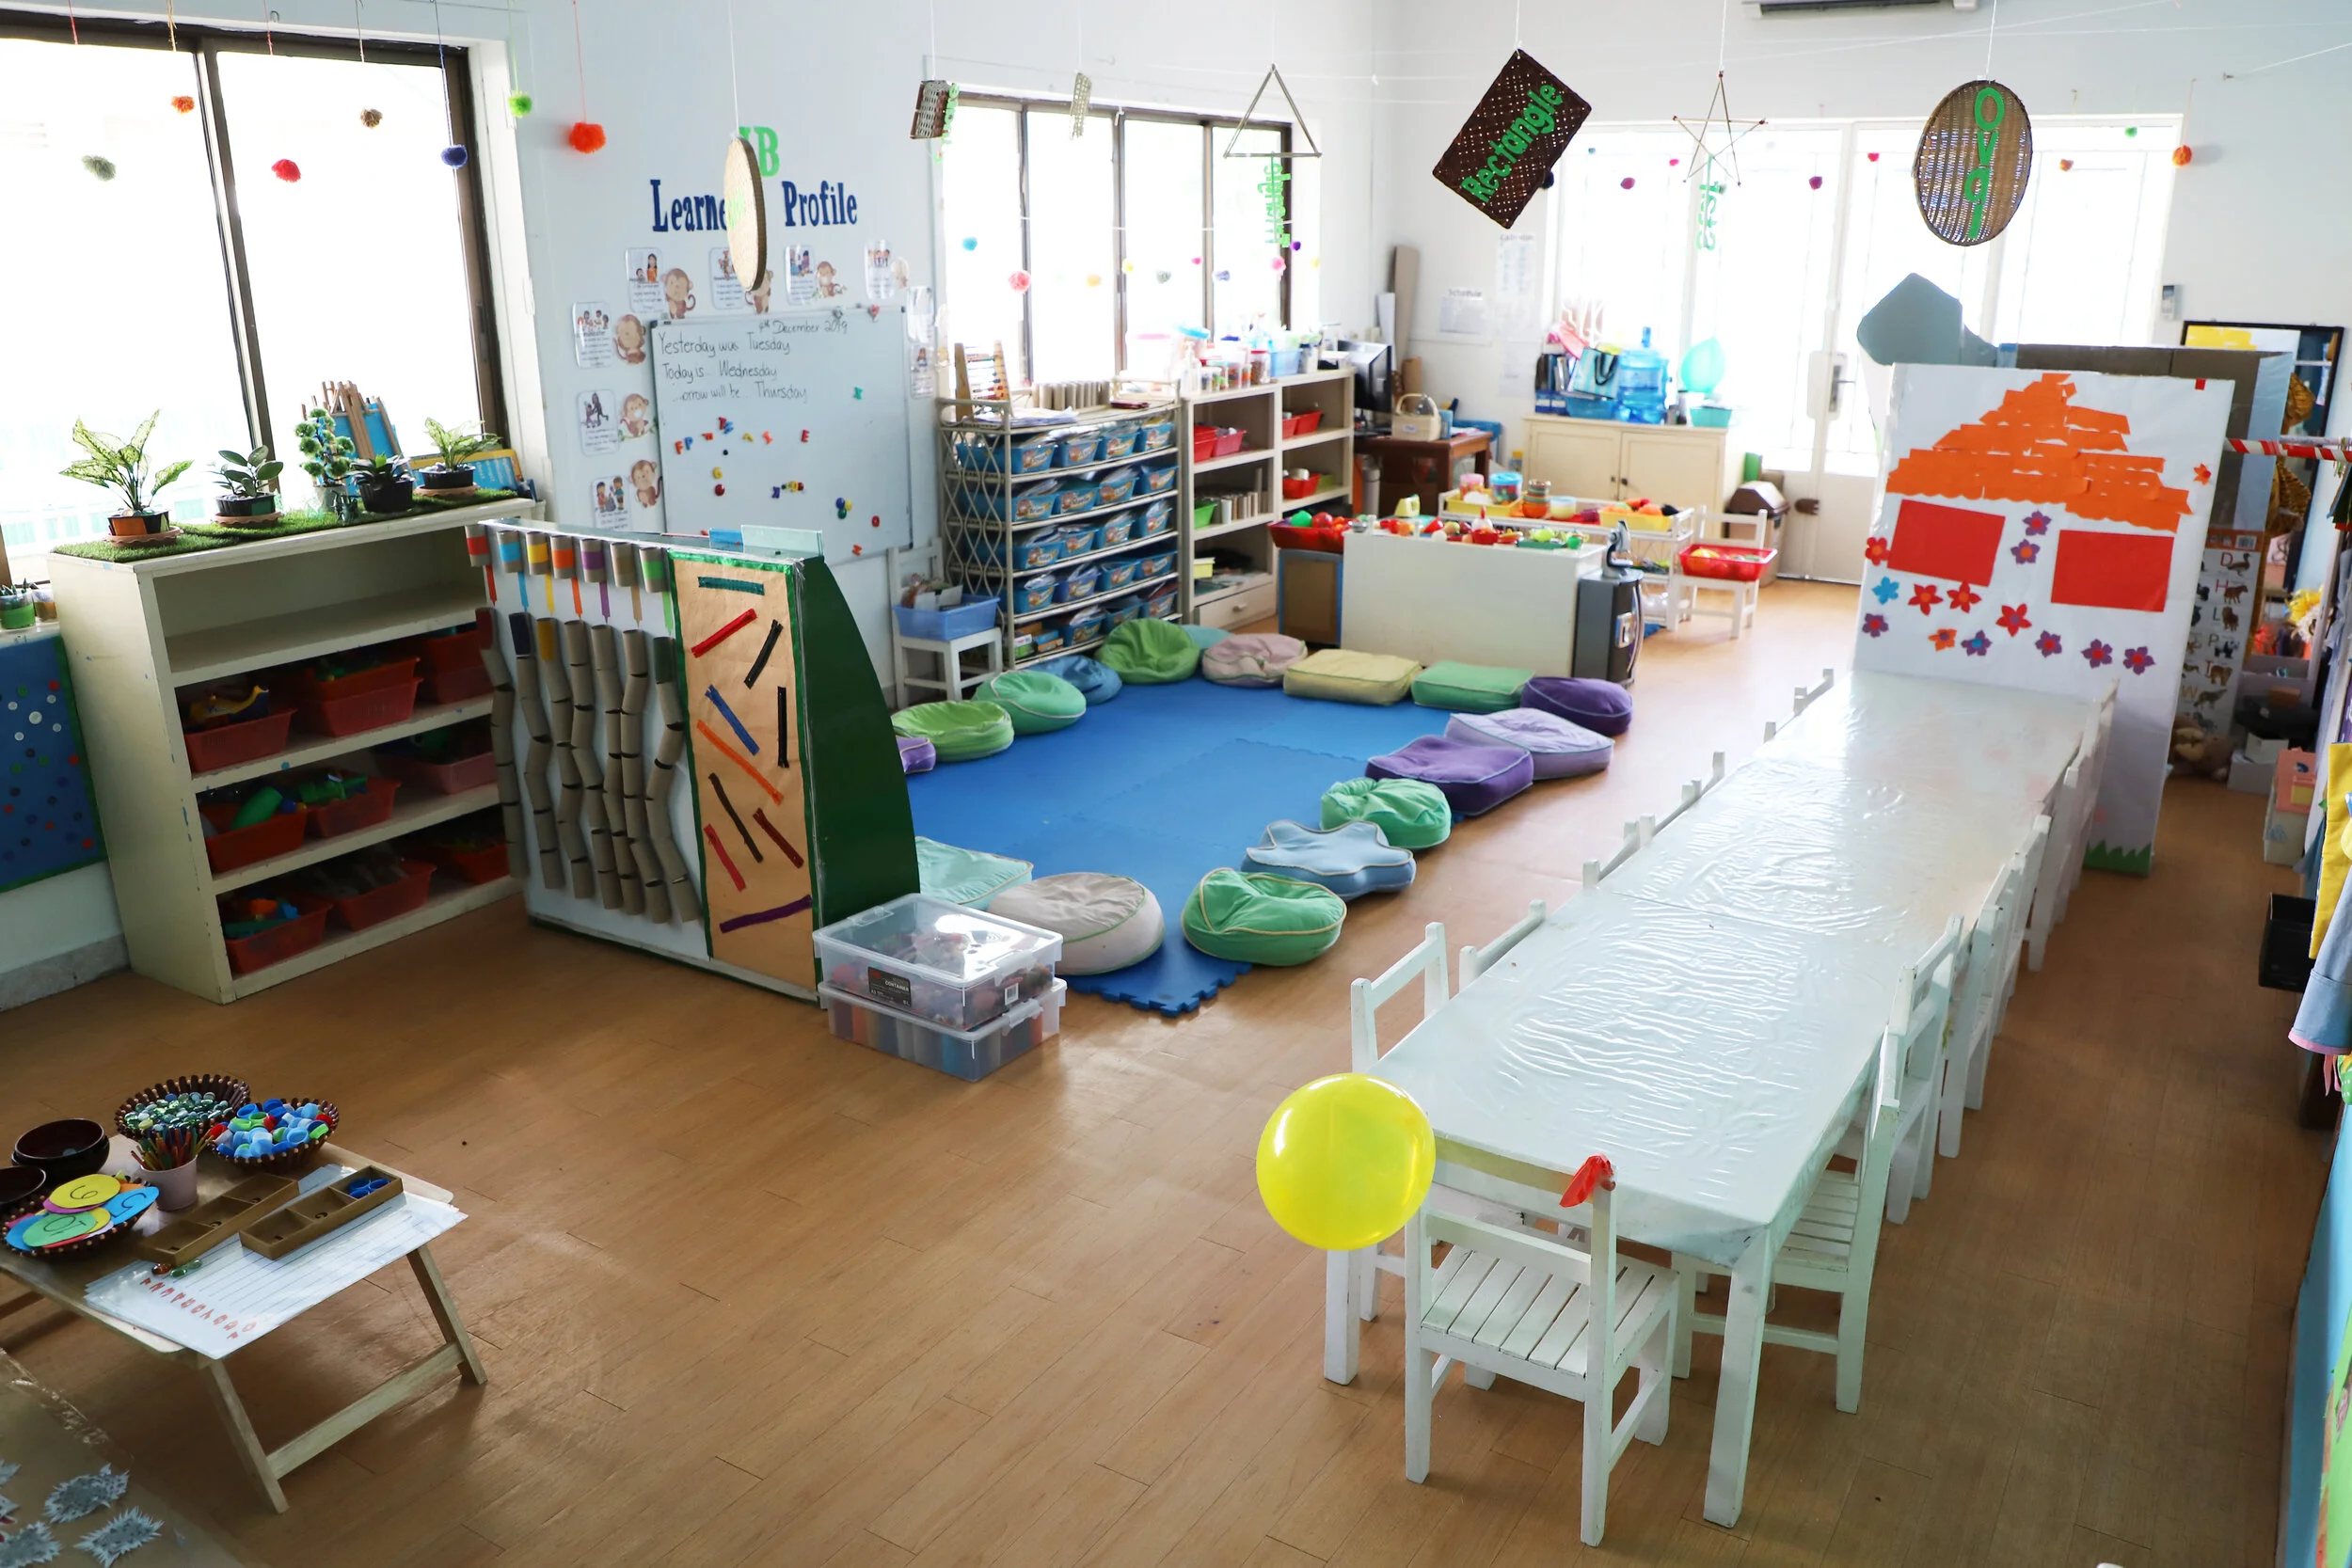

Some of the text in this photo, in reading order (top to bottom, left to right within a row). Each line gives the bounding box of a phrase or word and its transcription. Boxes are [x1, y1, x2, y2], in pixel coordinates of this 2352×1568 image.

[1460, 83, 1564, 203] Rectangle
[649, 178, 728, 232] Learne
[782, 180, 858, 227] Profile
[772, 320, 819, 334] December
[824, 319, 848, 335] 2019
[659, 332, 716, 357] Yesterday
[747, 331, 791, 356] Tuesday
[662, 363, 694, 384] Today
[719, 360, 777, 381] Wednesday
[710, 385, 726, 398] will
[729, 384, 739, 399] be
[755, 380, 807, 404] Thursday
[2220, 551, 2233, 567] D
[2215, 578, 2229, 594] H
[2213, 607, 2220, 621] L
[2208, 633, 2219, 647] P
